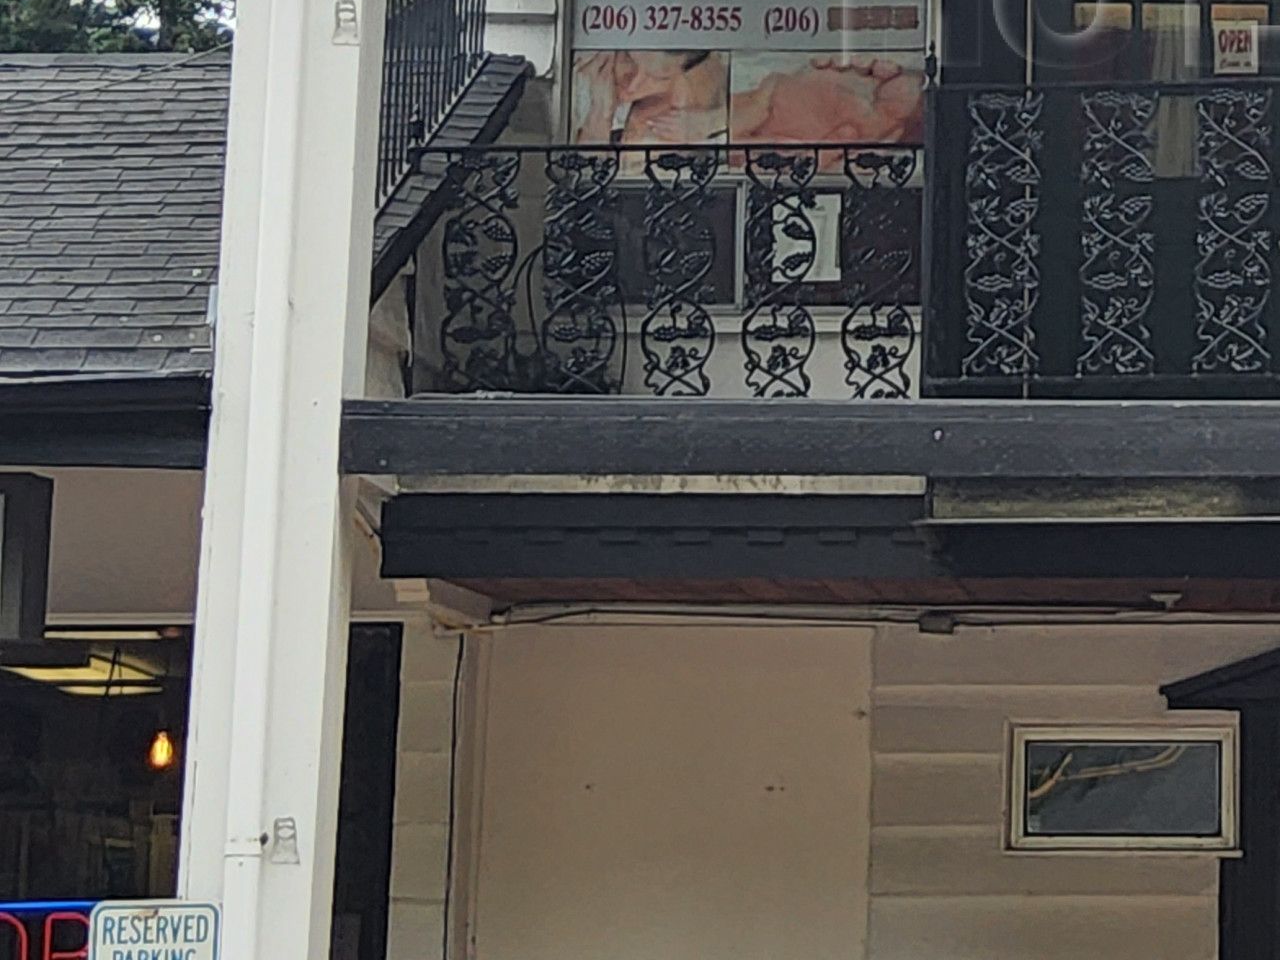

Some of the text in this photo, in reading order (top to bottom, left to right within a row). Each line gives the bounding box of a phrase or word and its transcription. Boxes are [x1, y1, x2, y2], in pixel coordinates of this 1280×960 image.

[581, 6, 637, 35] (206)
[643, 6, 743, 32] 327-8355
[764, 7, 820, 38] (206)
[1218, 28, 1253, 54] OPEN
[103, 914, 210, 945] RESERVED
